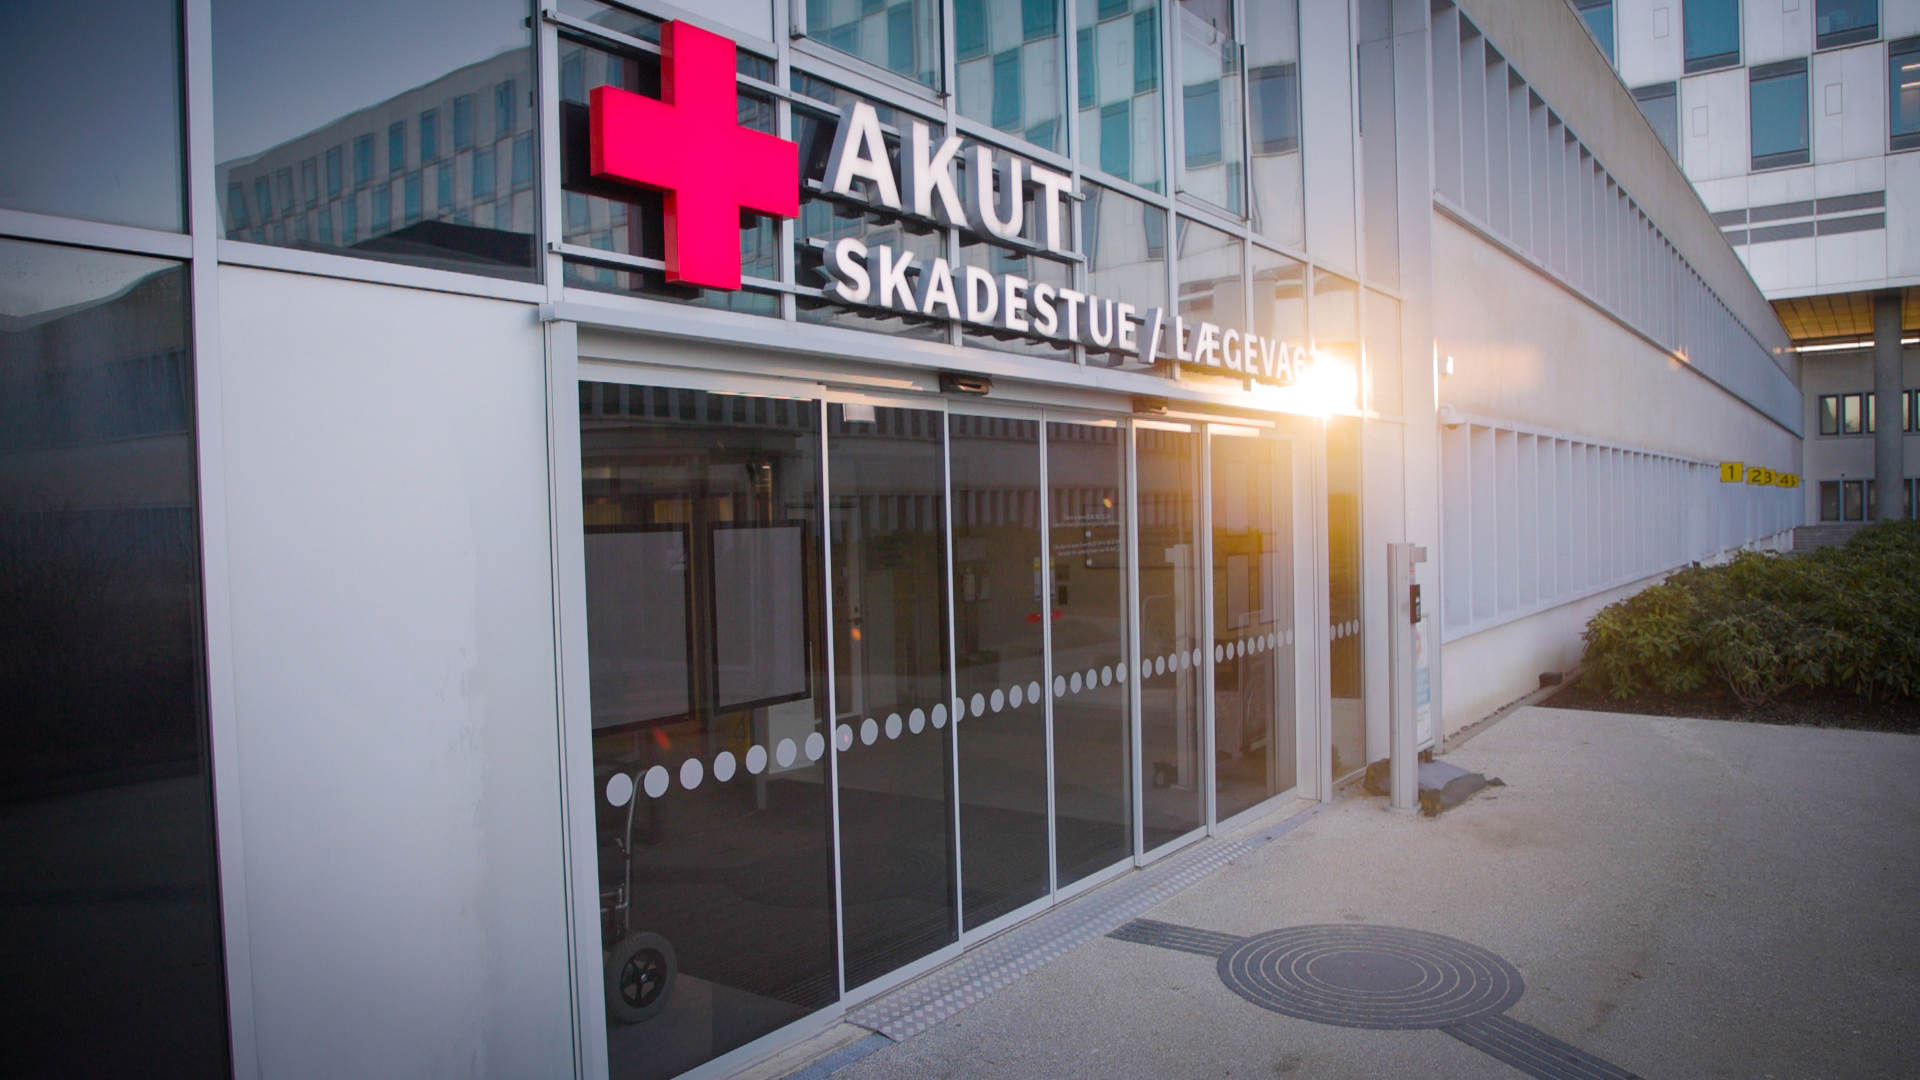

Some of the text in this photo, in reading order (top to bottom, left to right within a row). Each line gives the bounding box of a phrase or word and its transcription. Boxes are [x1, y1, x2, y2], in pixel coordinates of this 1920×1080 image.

[831, 101, 1072, 251] AKUT
[833, 237, 1137, 350] SKADESTUE
[1146, 306, 1164, 364] /
[1728, 465, 1734, 480] 1
[1751, 470, 1762, 482] 2
[1780, 474, 1789, 485] 4
